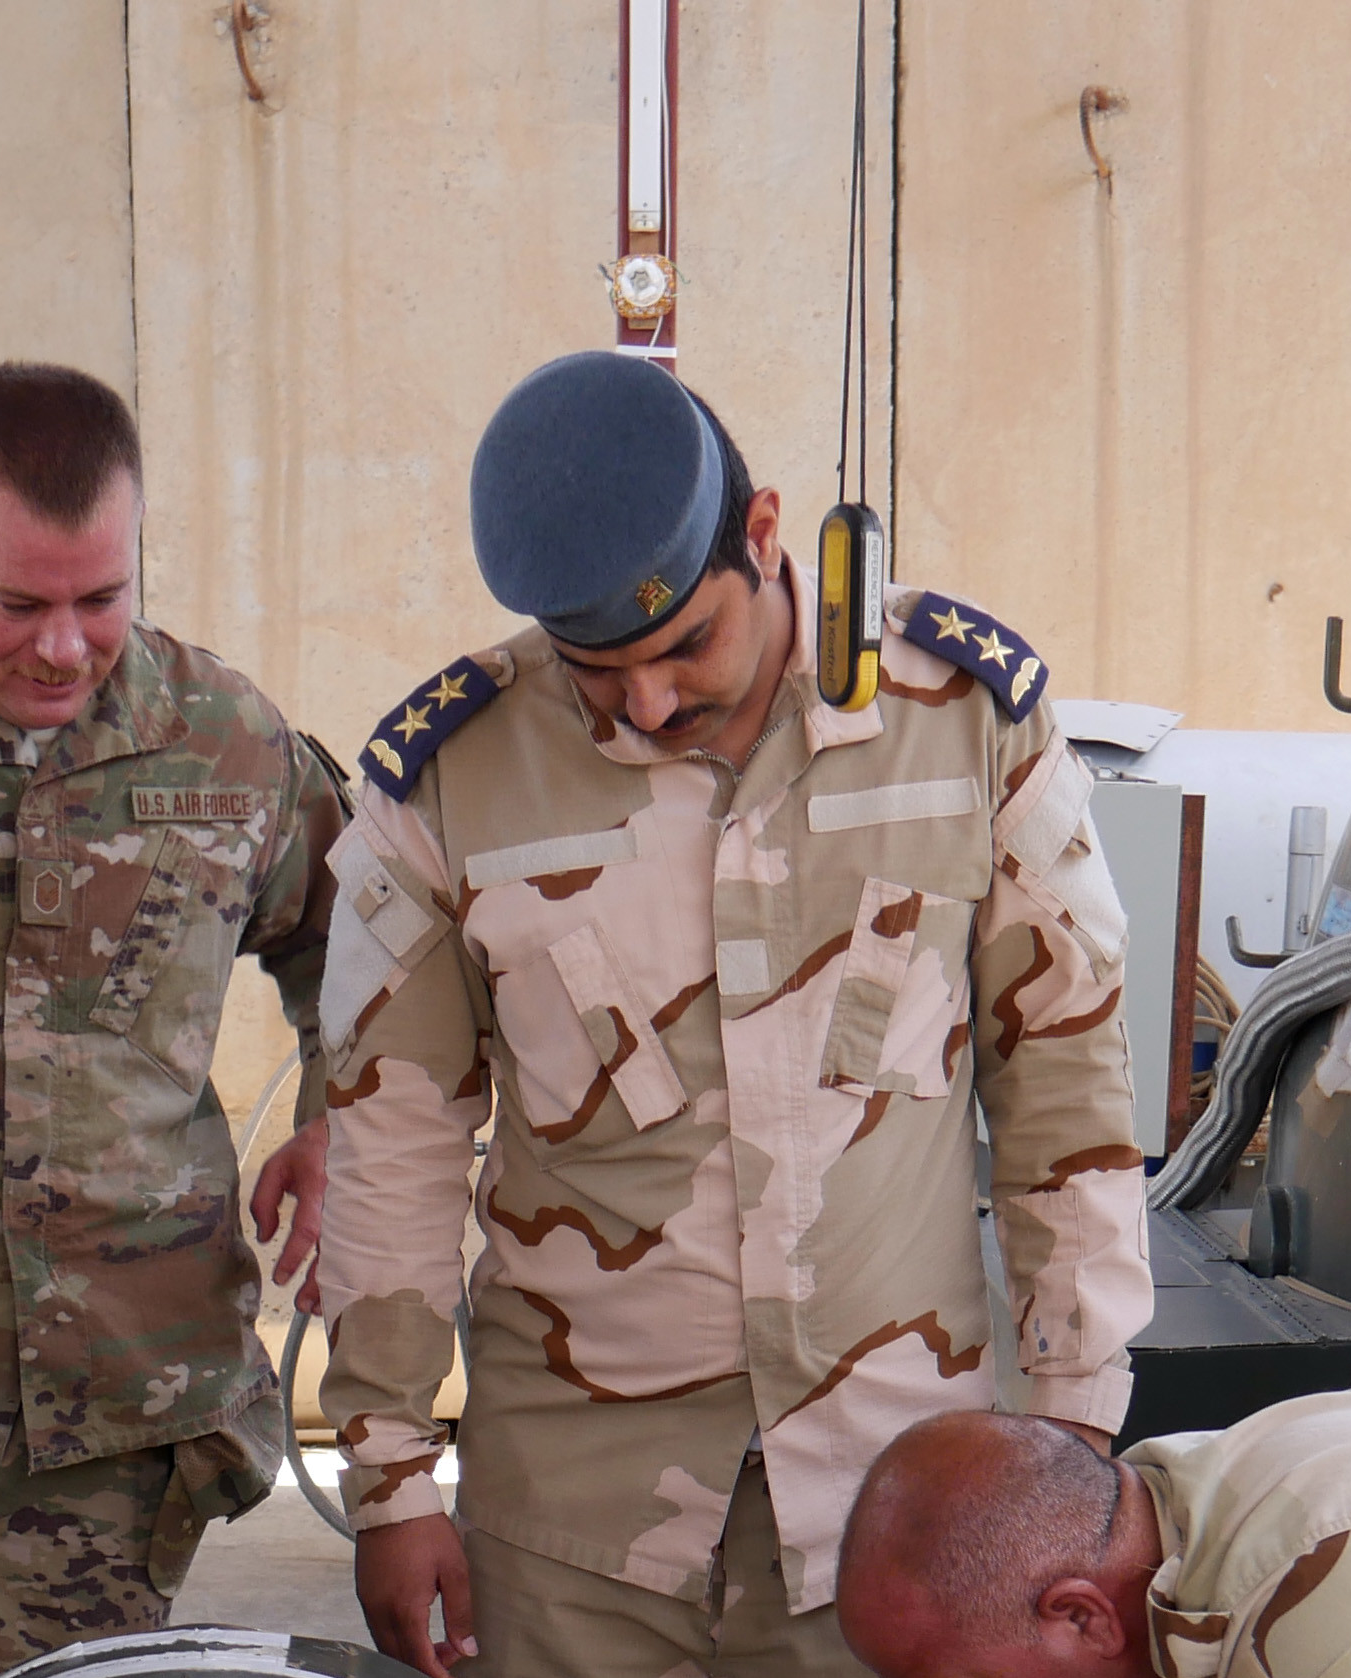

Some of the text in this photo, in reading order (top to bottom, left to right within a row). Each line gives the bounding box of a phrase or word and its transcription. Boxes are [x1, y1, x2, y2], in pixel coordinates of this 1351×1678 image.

[870, 539, 879, 632] REFERENCE ONLY
[136, 792, 252, 818] U.S. AIR FORCE
